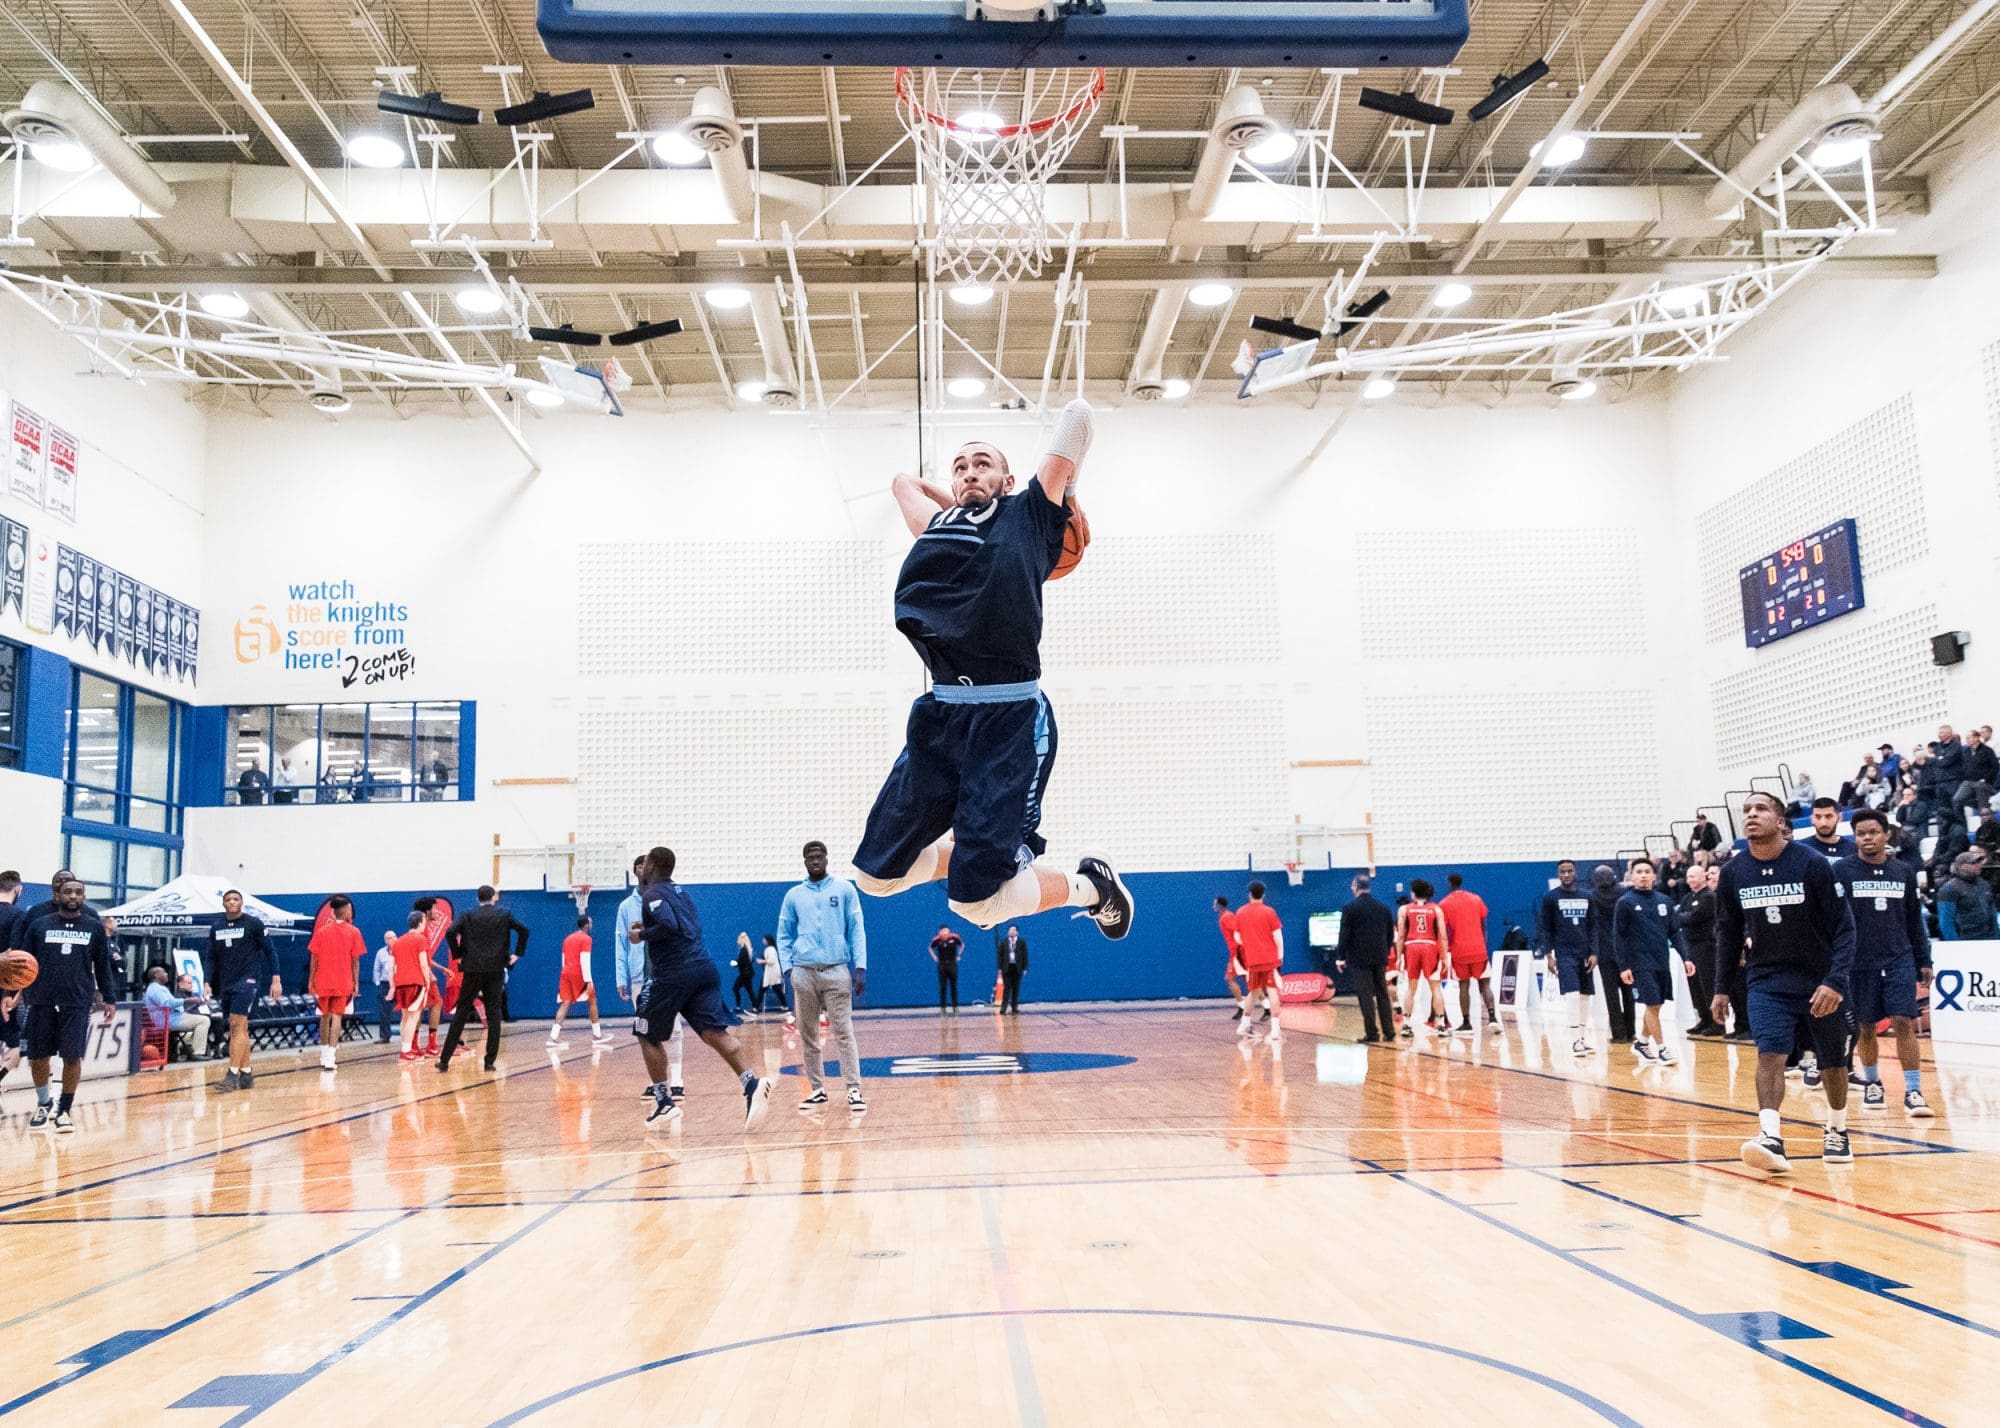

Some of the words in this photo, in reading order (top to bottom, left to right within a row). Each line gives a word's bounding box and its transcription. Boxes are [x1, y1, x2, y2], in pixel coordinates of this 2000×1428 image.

[15, 420, 41, 443] OCAA
[50, 440, 75, 463] OCAA
[1813, 543, 1824, 565] 0
[1767, 565, 1777, 585] 0
[288, 579, 354, 600] watch
[287, 603, 321, 623] the
[328, 601, 408, 627] knights
[287, 628, 347, 647] score
[355, 624, 404, 645] from
[285, 648, 341, 669] here!
[361, 648, 411, 672] COME
[365, 669, 385, 685] ON
[389, 656, 415, 681] UP!
[1739, 882, 1805, 900] SHERIDAN
[1852, 880, 1906, 891] SHERIDAN
[829, 896, 839, 908] S
[116, 913, 193, 926] oknights.ca
[1416, 915, 1427, 932] 3
